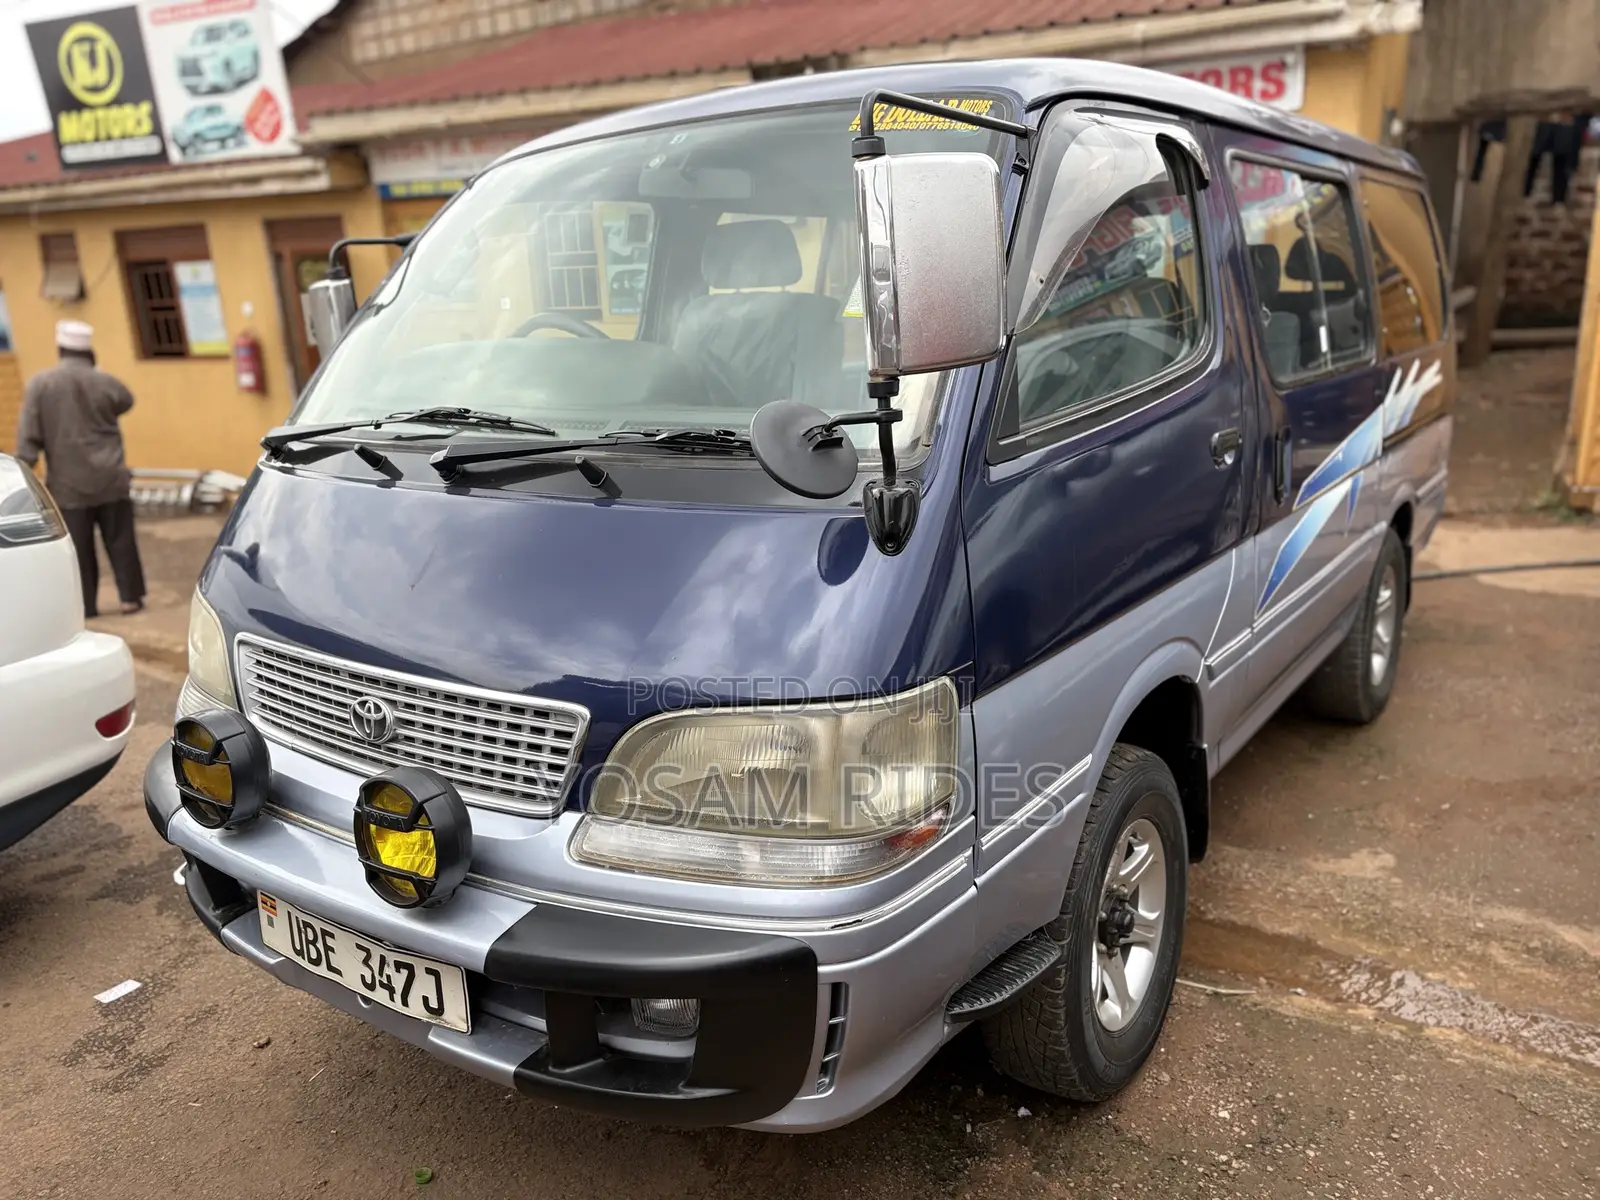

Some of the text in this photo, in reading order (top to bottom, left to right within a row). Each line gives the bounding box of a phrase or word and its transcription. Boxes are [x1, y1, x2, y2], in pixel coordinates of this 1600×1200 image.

[1178, 59, 1287, 101] ORS
[363, 808, 406, 831] TOYOTA
[287, 909, 446, 1017] UBE 347J
